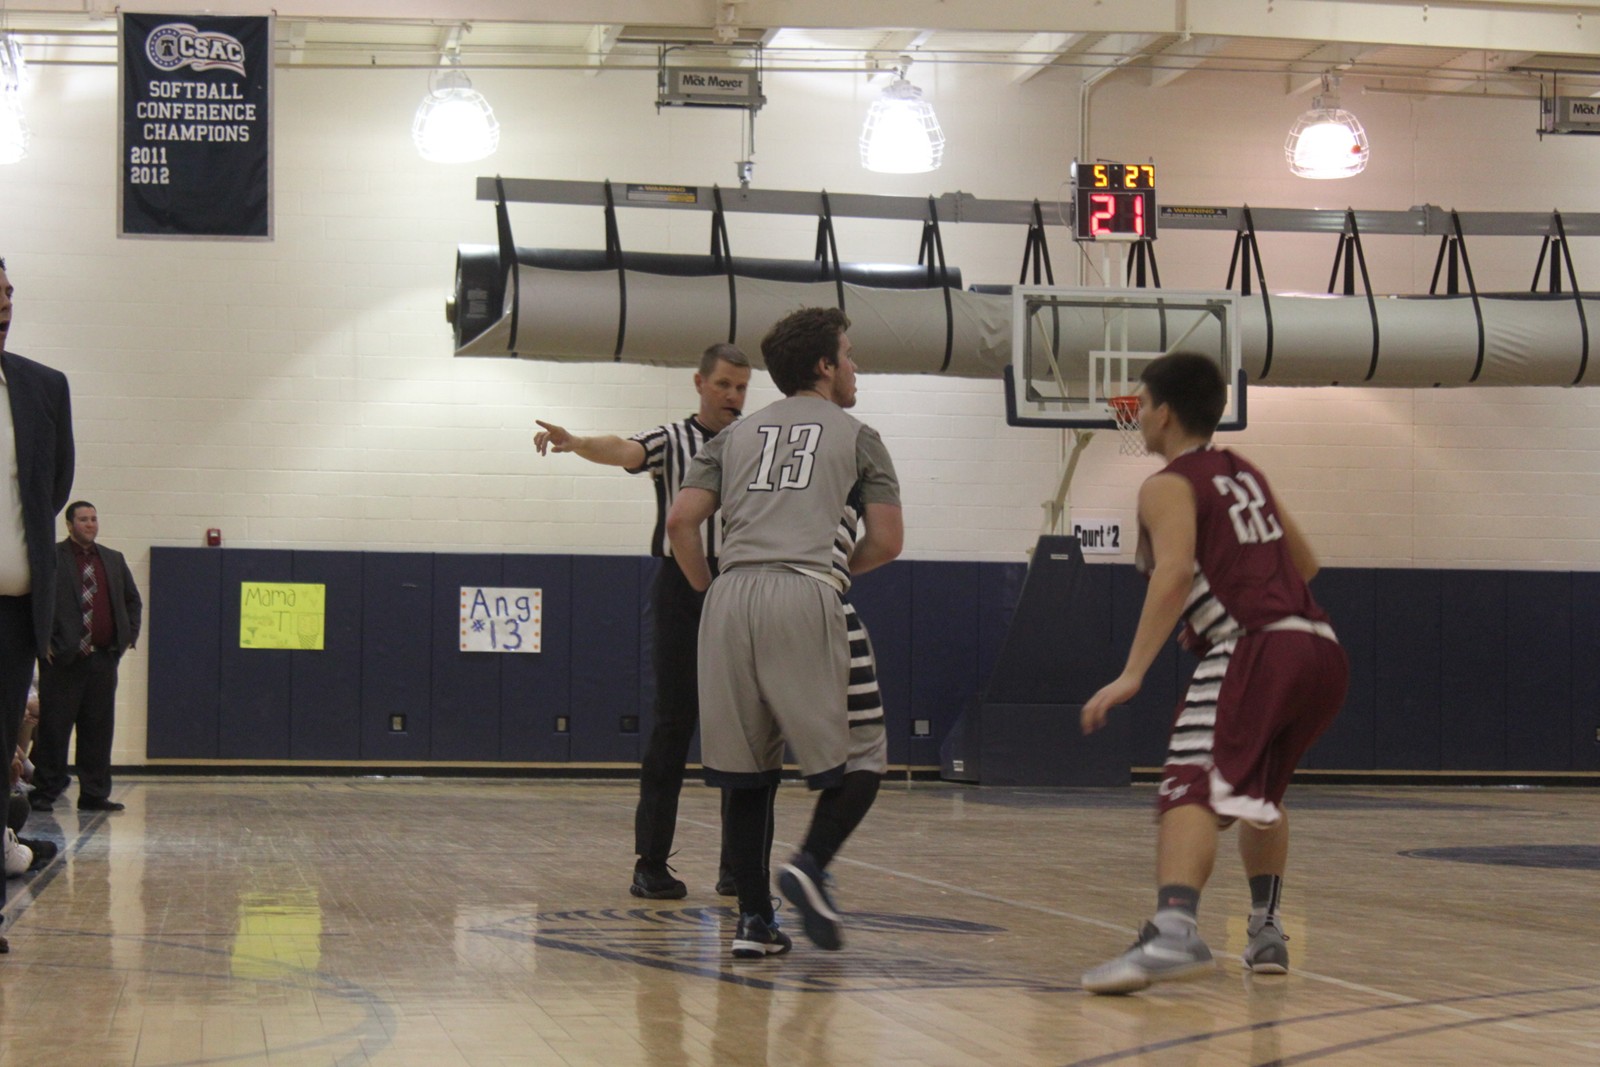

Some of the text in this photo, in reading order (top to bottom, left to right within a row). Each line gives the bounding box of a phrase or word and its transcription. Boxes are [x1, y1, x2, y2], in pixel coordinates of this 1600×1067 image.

[179, 36, 242, 61] CSAC
[150, 81, 243, 99] SOFTBALL
[683, 74, 743, 88] Mat Mover
[137, 102, 256, 120] CONFERENCE
[1573, 103, 1595, 114] Mat
[144, 124, 249, 142] CHAMPIONS
[131, 147, 167, 164] 2011
[131, 167, 170, 184] 2012
[1091, 195, 1143, 235] 21
[747, 423, 823, 491] 13
[1212, 471, 1283, 544] 22
[1074, 525, 1104, 547] Court
[245, 588, 296, 607] Mama
[470, 589, 531, 622] Ang
